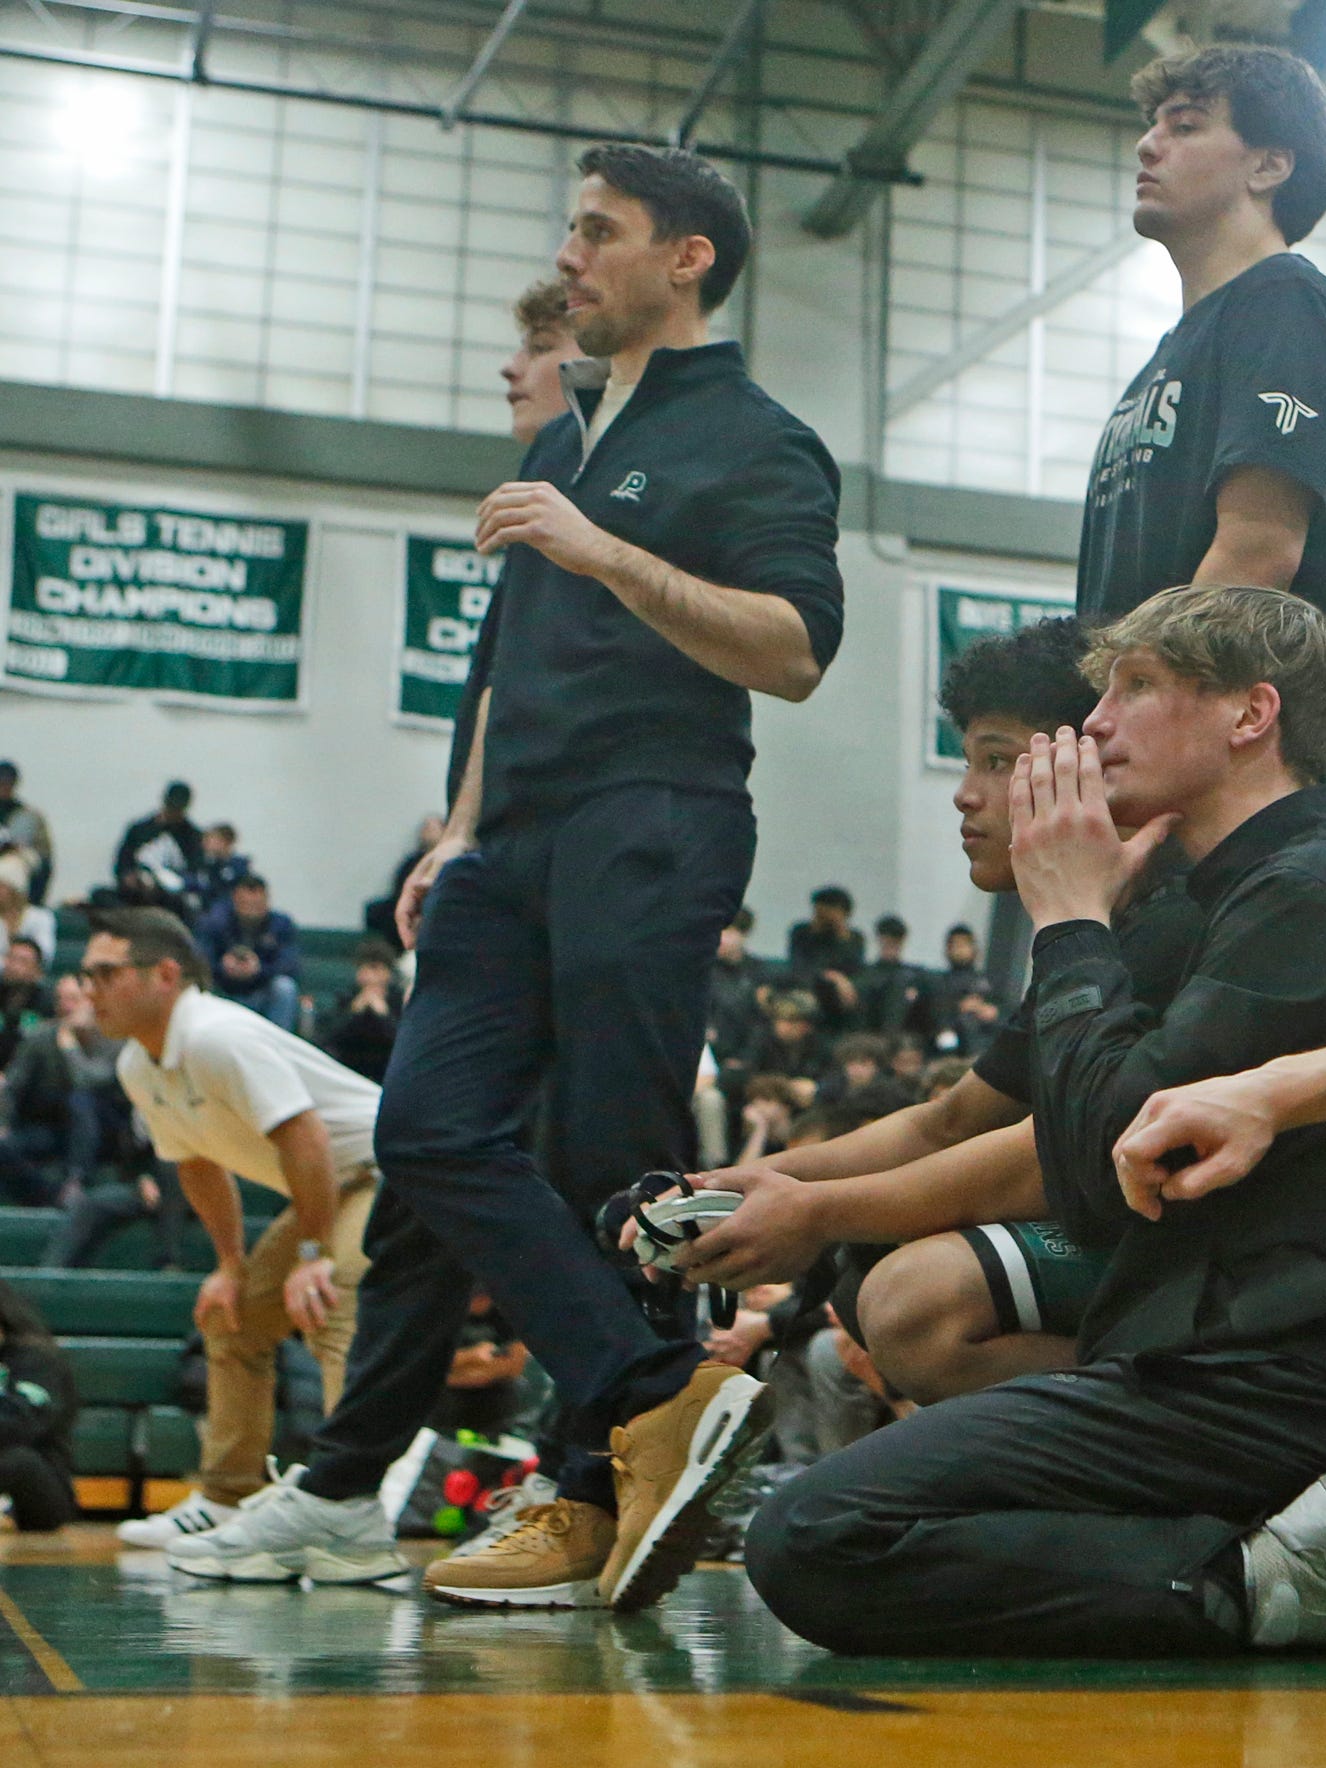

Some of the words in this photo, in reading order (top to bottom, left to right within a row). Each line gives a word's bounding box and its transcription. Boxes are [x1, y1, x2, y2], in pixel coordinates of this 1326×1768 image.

[35, 502, 147, 546] GIRLS
[155, 510, 285, 559] TENNIS
[68, 544, 248, 593] DIVISION
[34, 575, 279, 631] CHAMPIONS
